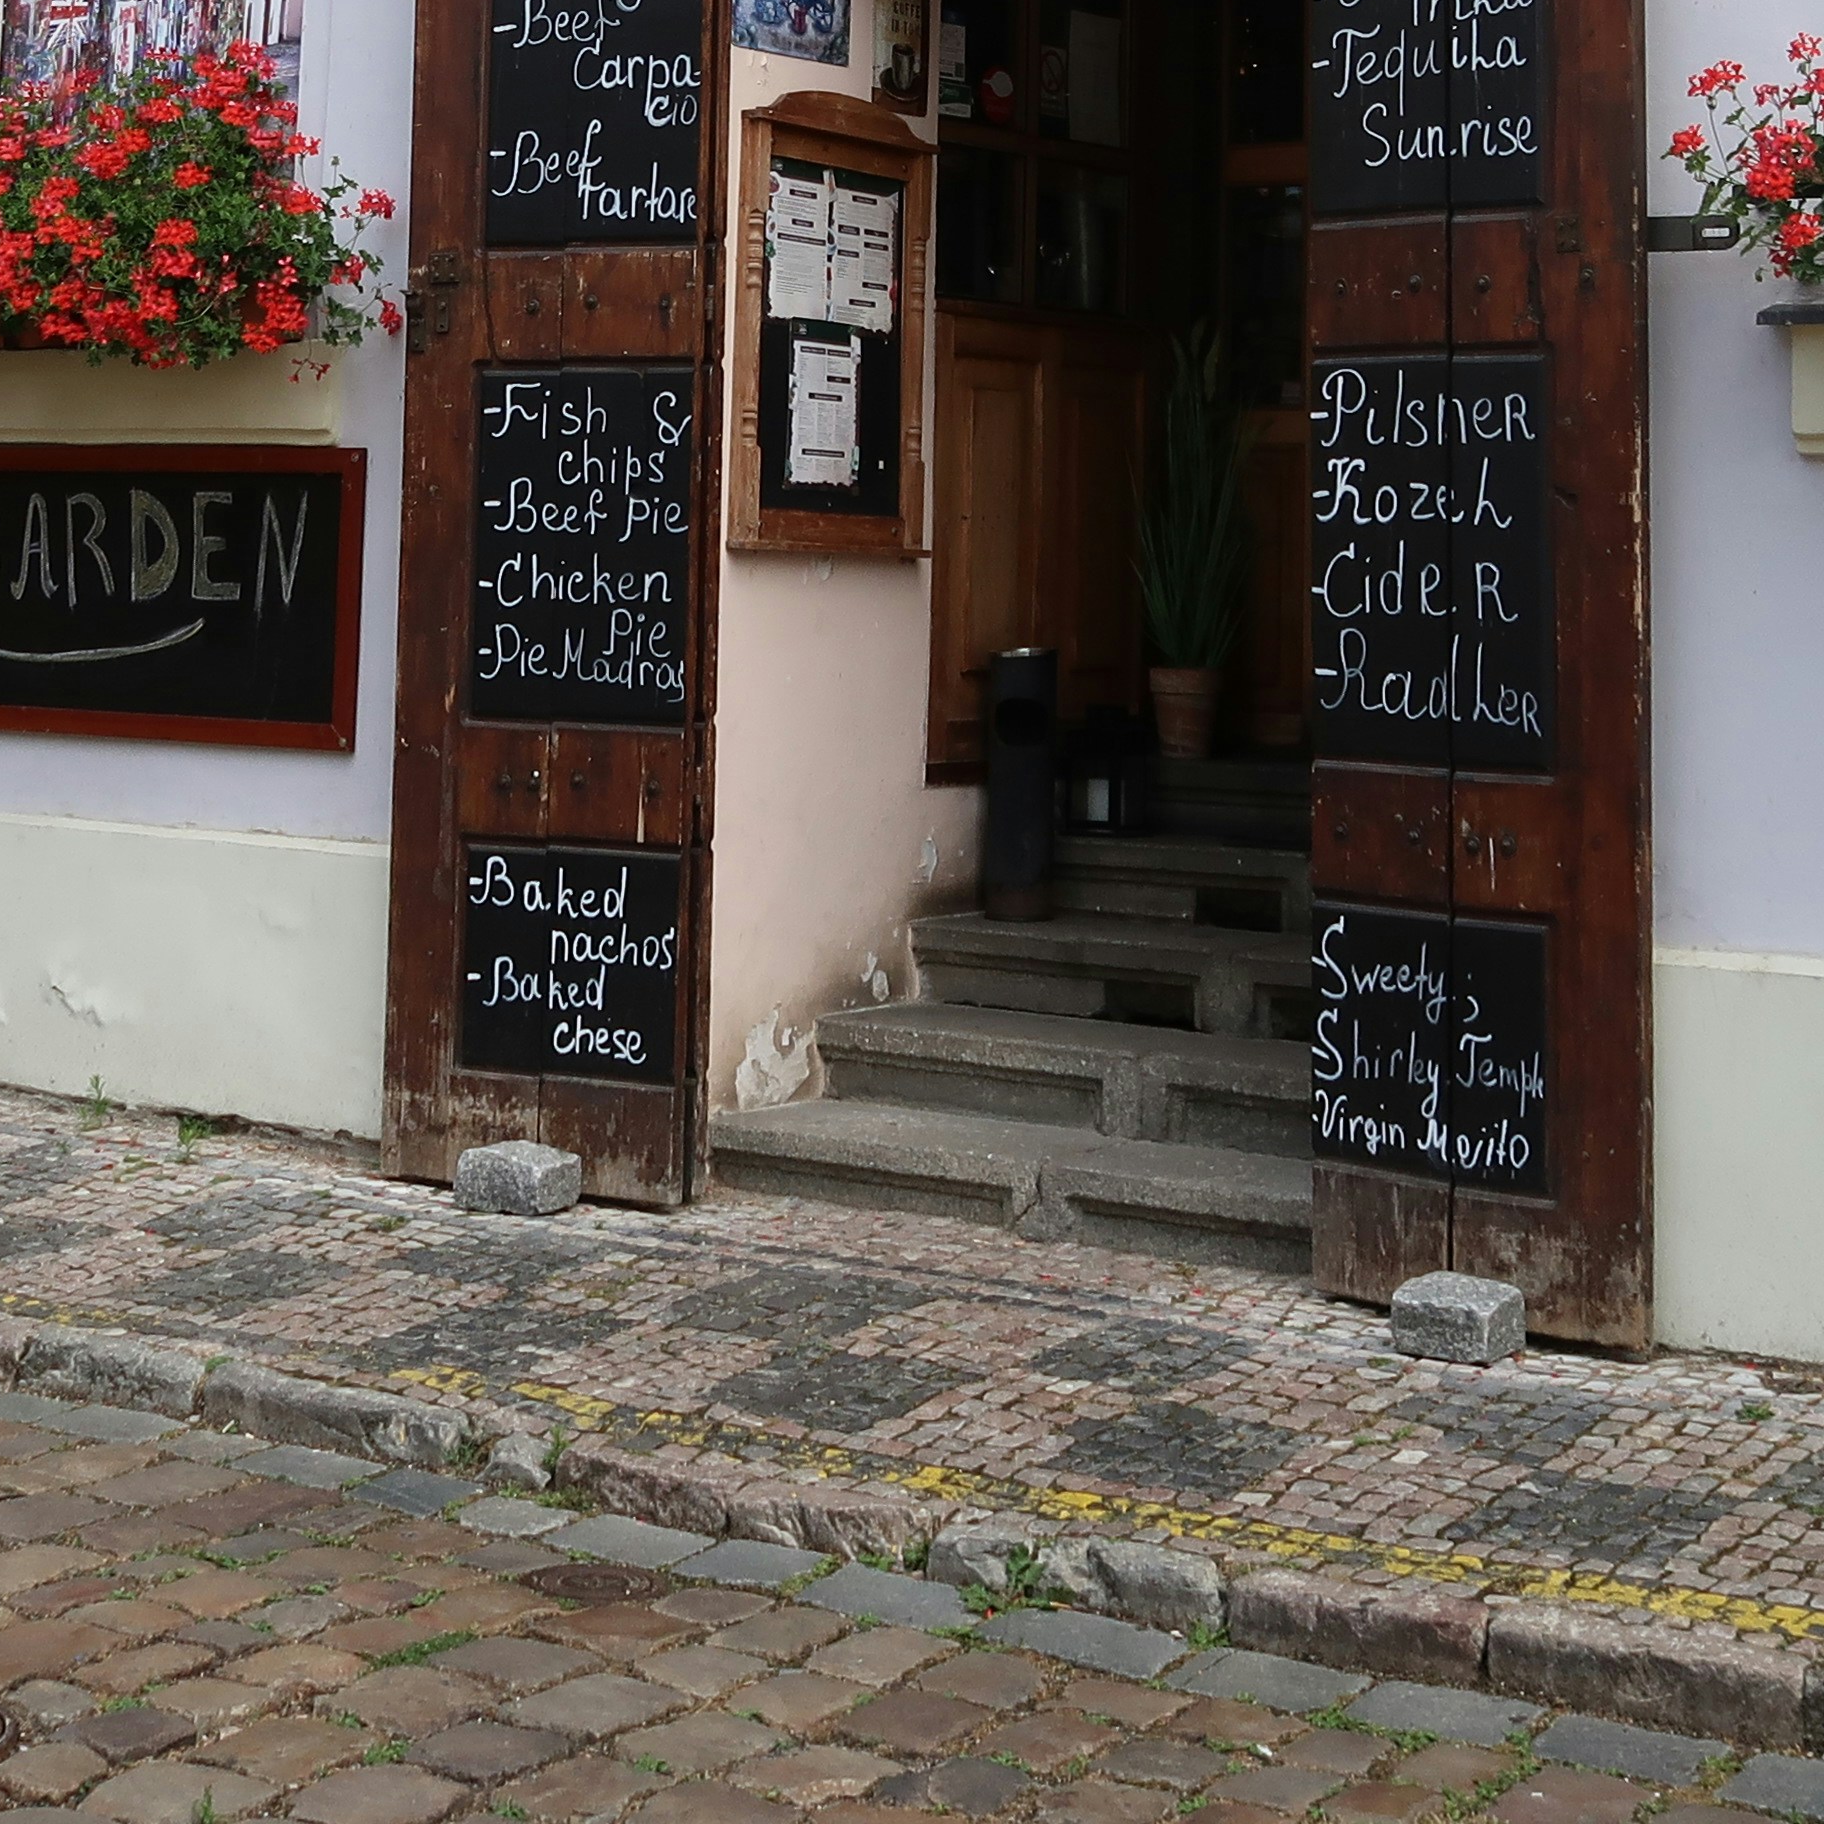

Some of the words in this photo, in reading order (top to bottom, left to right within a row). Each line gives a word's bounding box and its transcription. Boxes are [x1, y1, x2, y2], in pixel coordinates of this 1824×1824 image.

[492, 119, 602, 196] Beef
[492, 382, 607, 439] Fish
[653, 391, 692, 446] &
[494, 477, 607, 535] Beef
[497, 552, 672, 607] Chicken
[480, 623, 548, 679] Pie
[602, 608, 671, 658] Pie
[470, 856, 626, 919] Baked
[551, 923, 675, 970] nachos
[483, 956, 605, 1011] Baked
[1314, 1008, 1439, 1118] Shirley
[1315, 1089, 1405, 1155] Virgin
